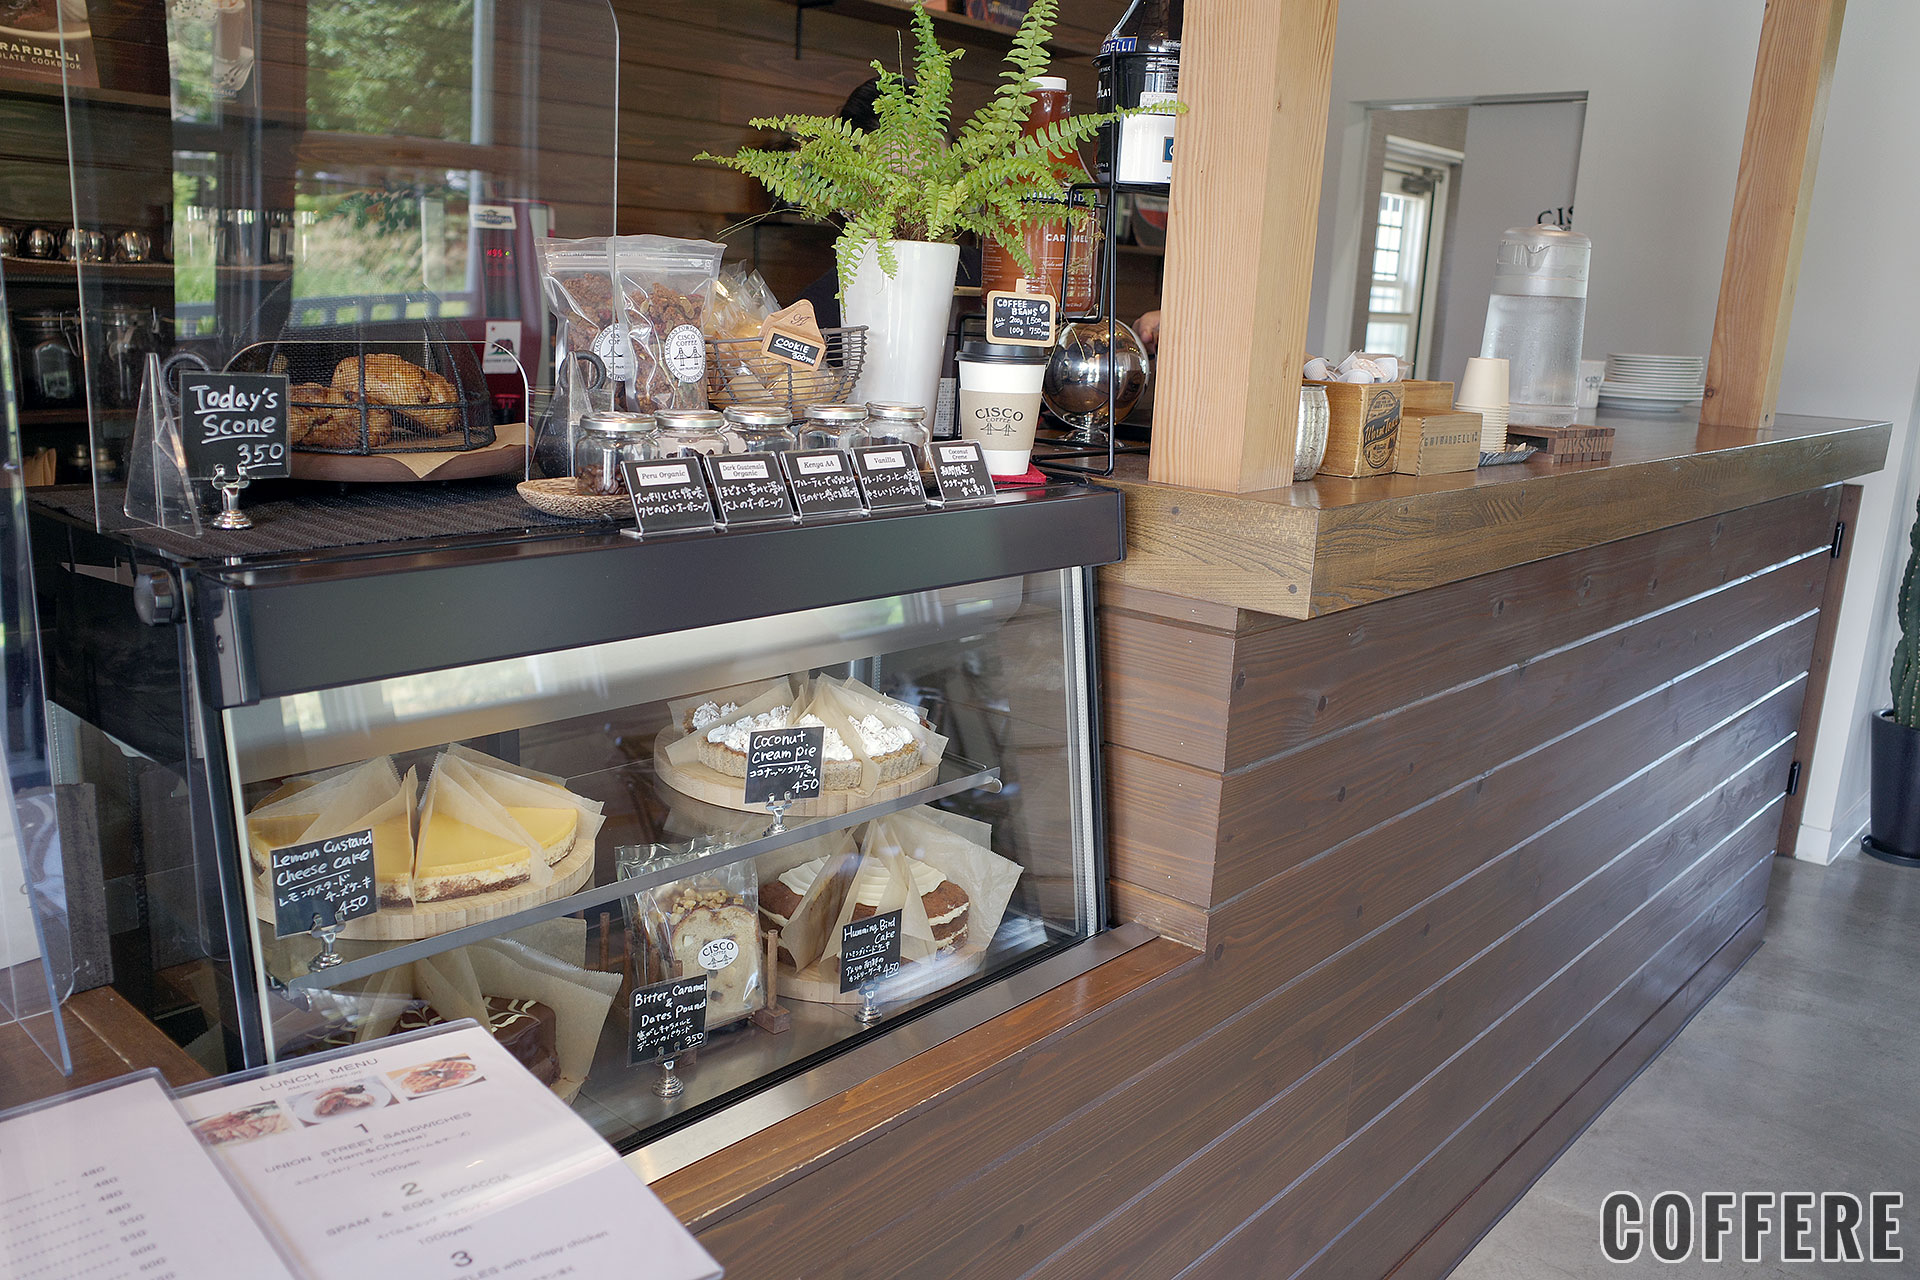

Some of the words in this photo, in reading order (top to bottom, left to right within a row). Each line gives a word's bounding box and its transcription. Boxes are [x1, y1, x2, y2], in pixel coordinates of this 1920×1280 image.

[1045, 233, 1089, 243] CARMEL
[996, 298, 1028, 308] COFFEE
[1011, 307, 1038, 317] BEANS
[774, 337, 811, 354] COOKIE
[188, 384, 279, 412] Today's
[975, 407, 1024, 422] CISCO
[202, 414, 277, 437] Scone
[237, 443, 285, 465] 350
[873, 456, 896, 464] Vanilla
[803, 461, 824, 469] Kenya
[659, 470, 686, 479] Organic
[733, 470, 758, 478] Organic
[753, 730, 807, 750] Coconut
[791, 778, 819, 794] 450
[273, 848, 320, 869] Lemon
[323, 830, 373, 854] Custard
[276, 862, 328, 887] Cheese
[324, 875, 372, 902] チーズケーキ
[338, 894, 369, 916] 450
[879, 916, 897, 932] Bird
[874, 930, 896, 945] Cake
[702, 941, 735, 957] CISCO
[883, 962, 900, 978] 450
[634, 990, 669, 1008] Bitter
[672, 980, 707, 997] Caramel
[665, 997, 673, 1009] &
[641, 1010, 673, 1028] Dates
[675, 997, 706, 1019] Pound
[684, 1032, 704, 1046] 350
[259, 1071, 320, 1092] LUNCH
[329, 1057, 379, 1076] MENU
[353, 1123, 369, 1134] 1
[264, 1156, 313, 1174] UNION
[320, 1137, 375, 1158] STREET
[383, 1111, 473, 1140] SANDWICHES
[401, 1181, 423, 1196] 2
[325, 1217, 371, 1237] SPAM
[402, 1198, 435, 1213] EGG
[451, 1249, 473, 1268] 3
